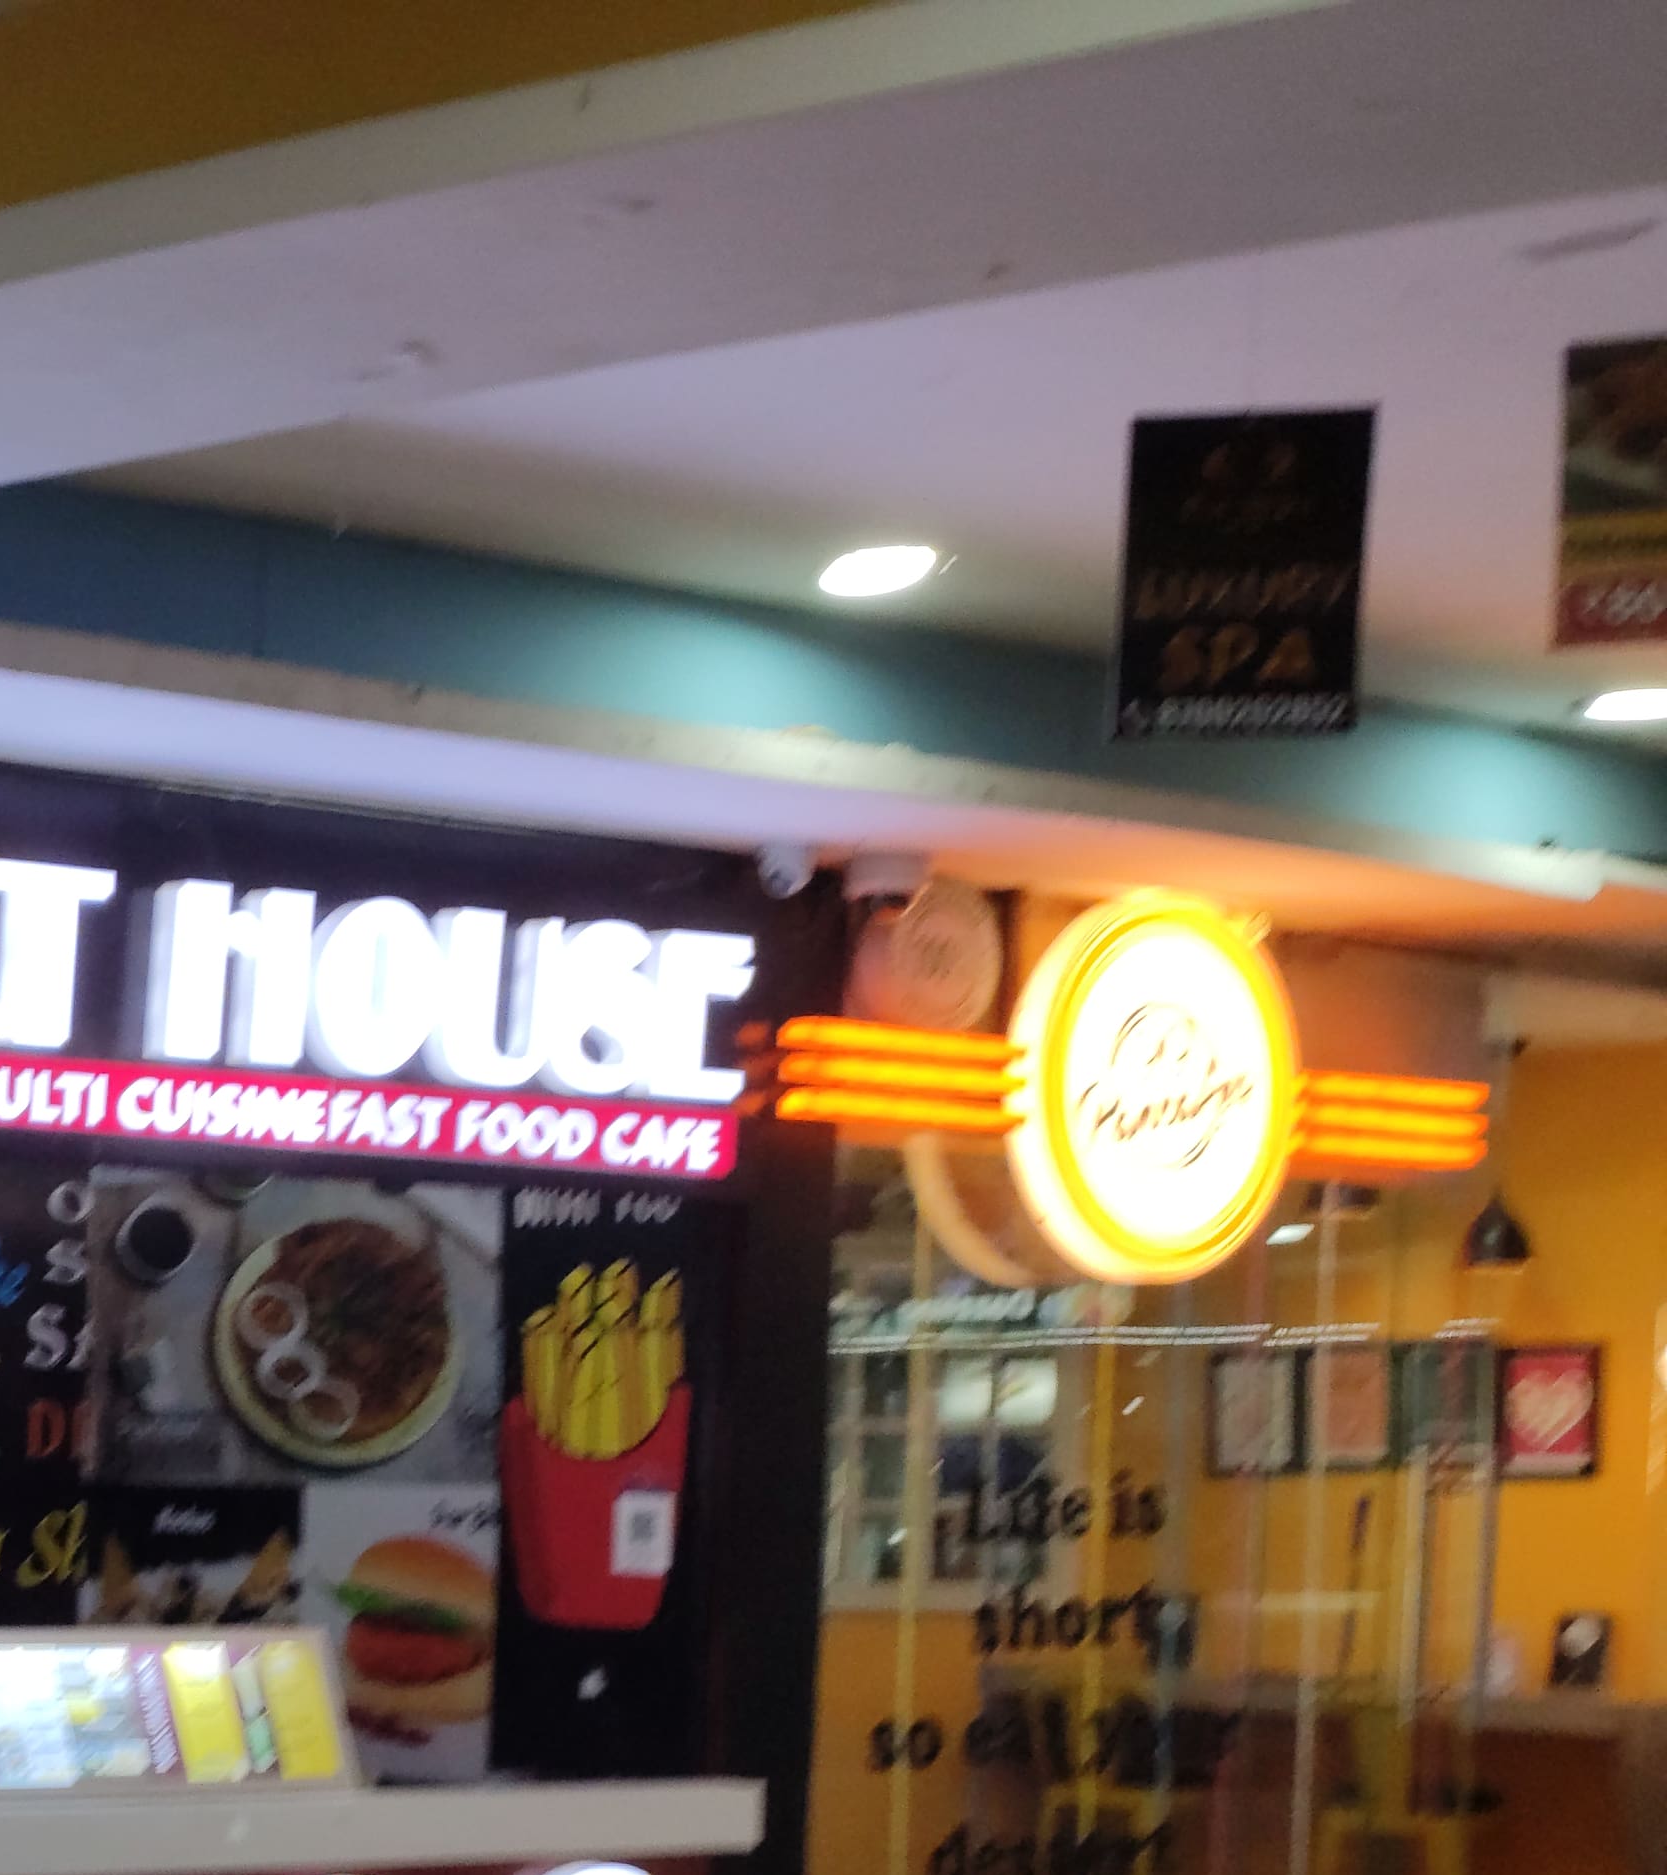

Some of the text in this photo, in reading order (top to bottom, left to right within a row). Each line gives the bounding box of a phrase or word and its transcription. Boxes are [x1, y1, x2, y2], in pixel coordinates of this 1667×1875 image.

[1157, 622, 1317, 693] SPA
[141, 879, 760, 1103] HOUSE
[116, 1076, 335, 1145] CUISINE
[323, 1087, 453, 1150] FAST
[455, 1098, 597, 1163] FOOD
[599, 1114, 725, 1173] CAFE
[1108, 1468, 1167, 1539] is
